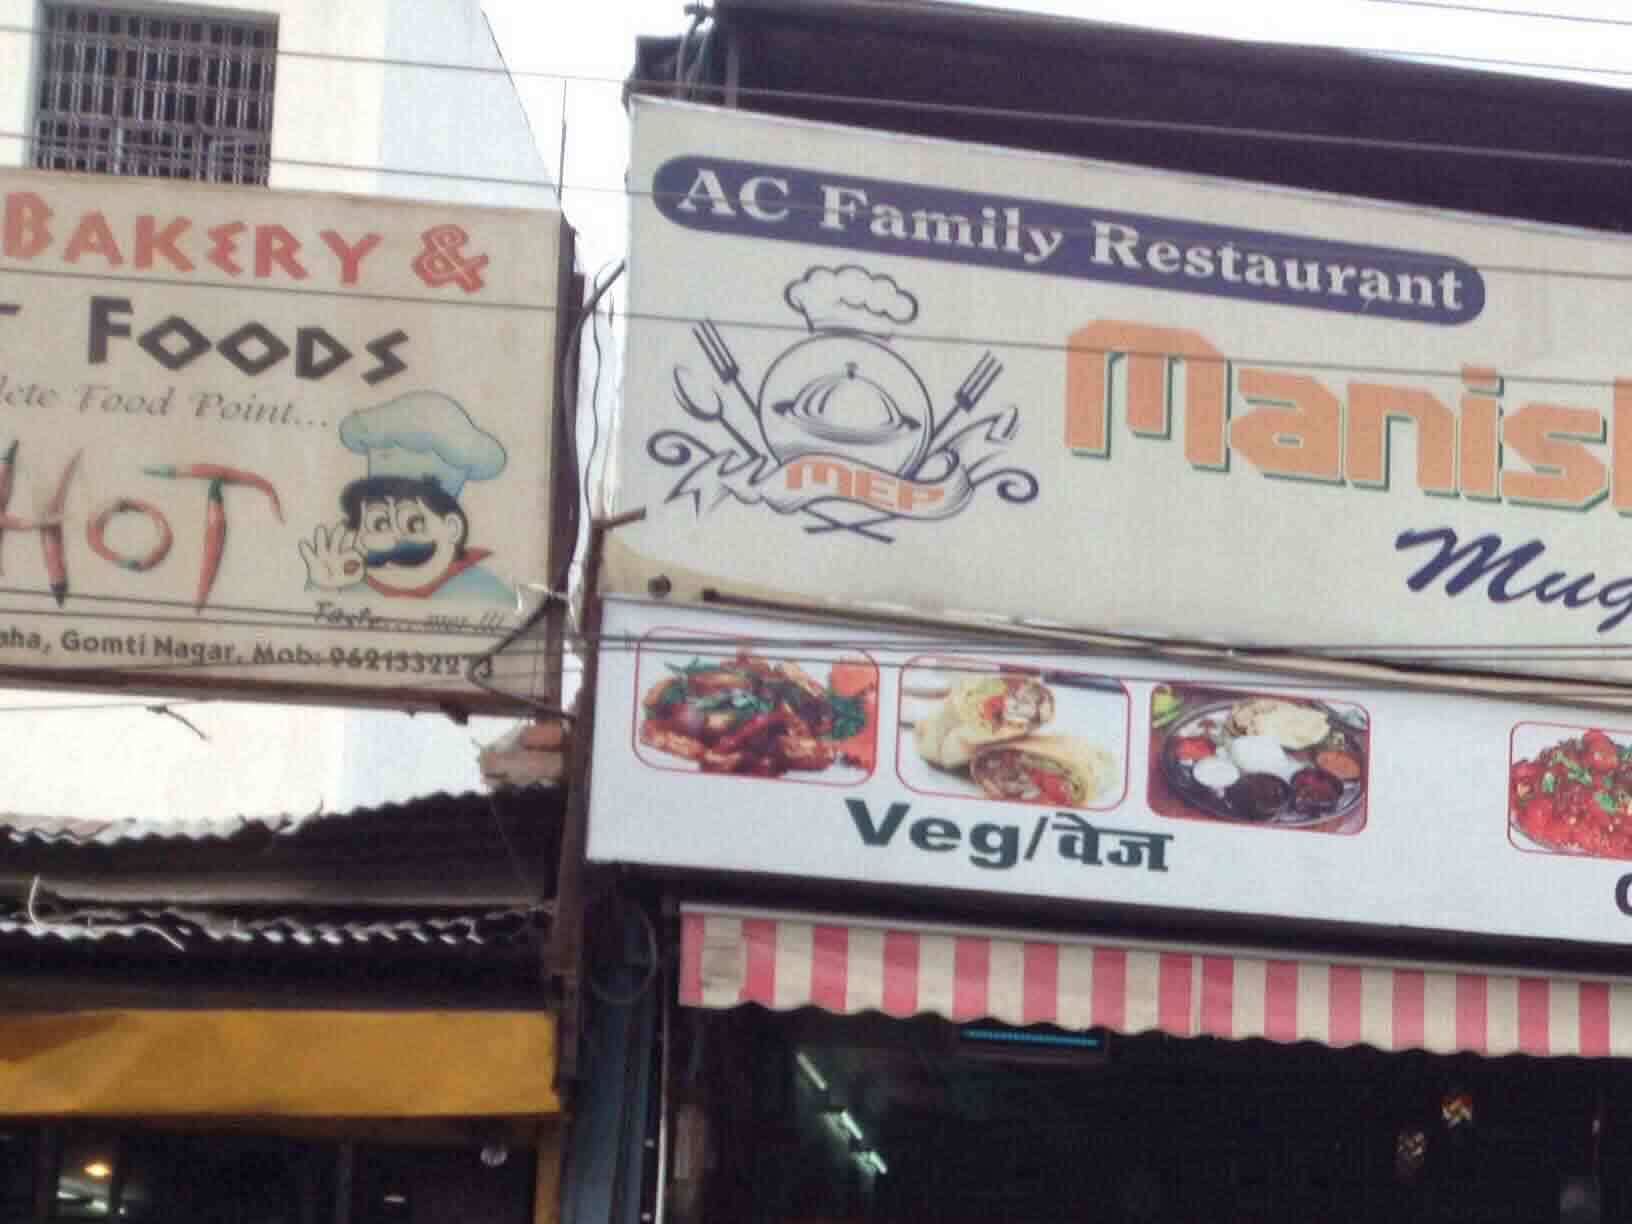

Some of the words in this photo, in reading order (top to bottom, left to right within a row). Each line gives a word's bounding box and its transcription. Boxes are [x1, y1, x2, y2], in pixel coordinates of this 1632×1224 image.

[1, 191, 383, 286] BAKERY
[411, 222, 490, 293] &
[677, 168, 791, 221] AC
[820, 184, 1063, 263] Family
[1089, 219, 1464, 312] Restaurant
[88, 296, 409, 385] FOODS
[73, 384, 176, 416] Food
[0, 438, 286, 614] HOT
[785, 460, 945, 513] MEP
[60, 627, 147, 658] Gomti
[844, 797, 1175, 873] Veg/वेज
